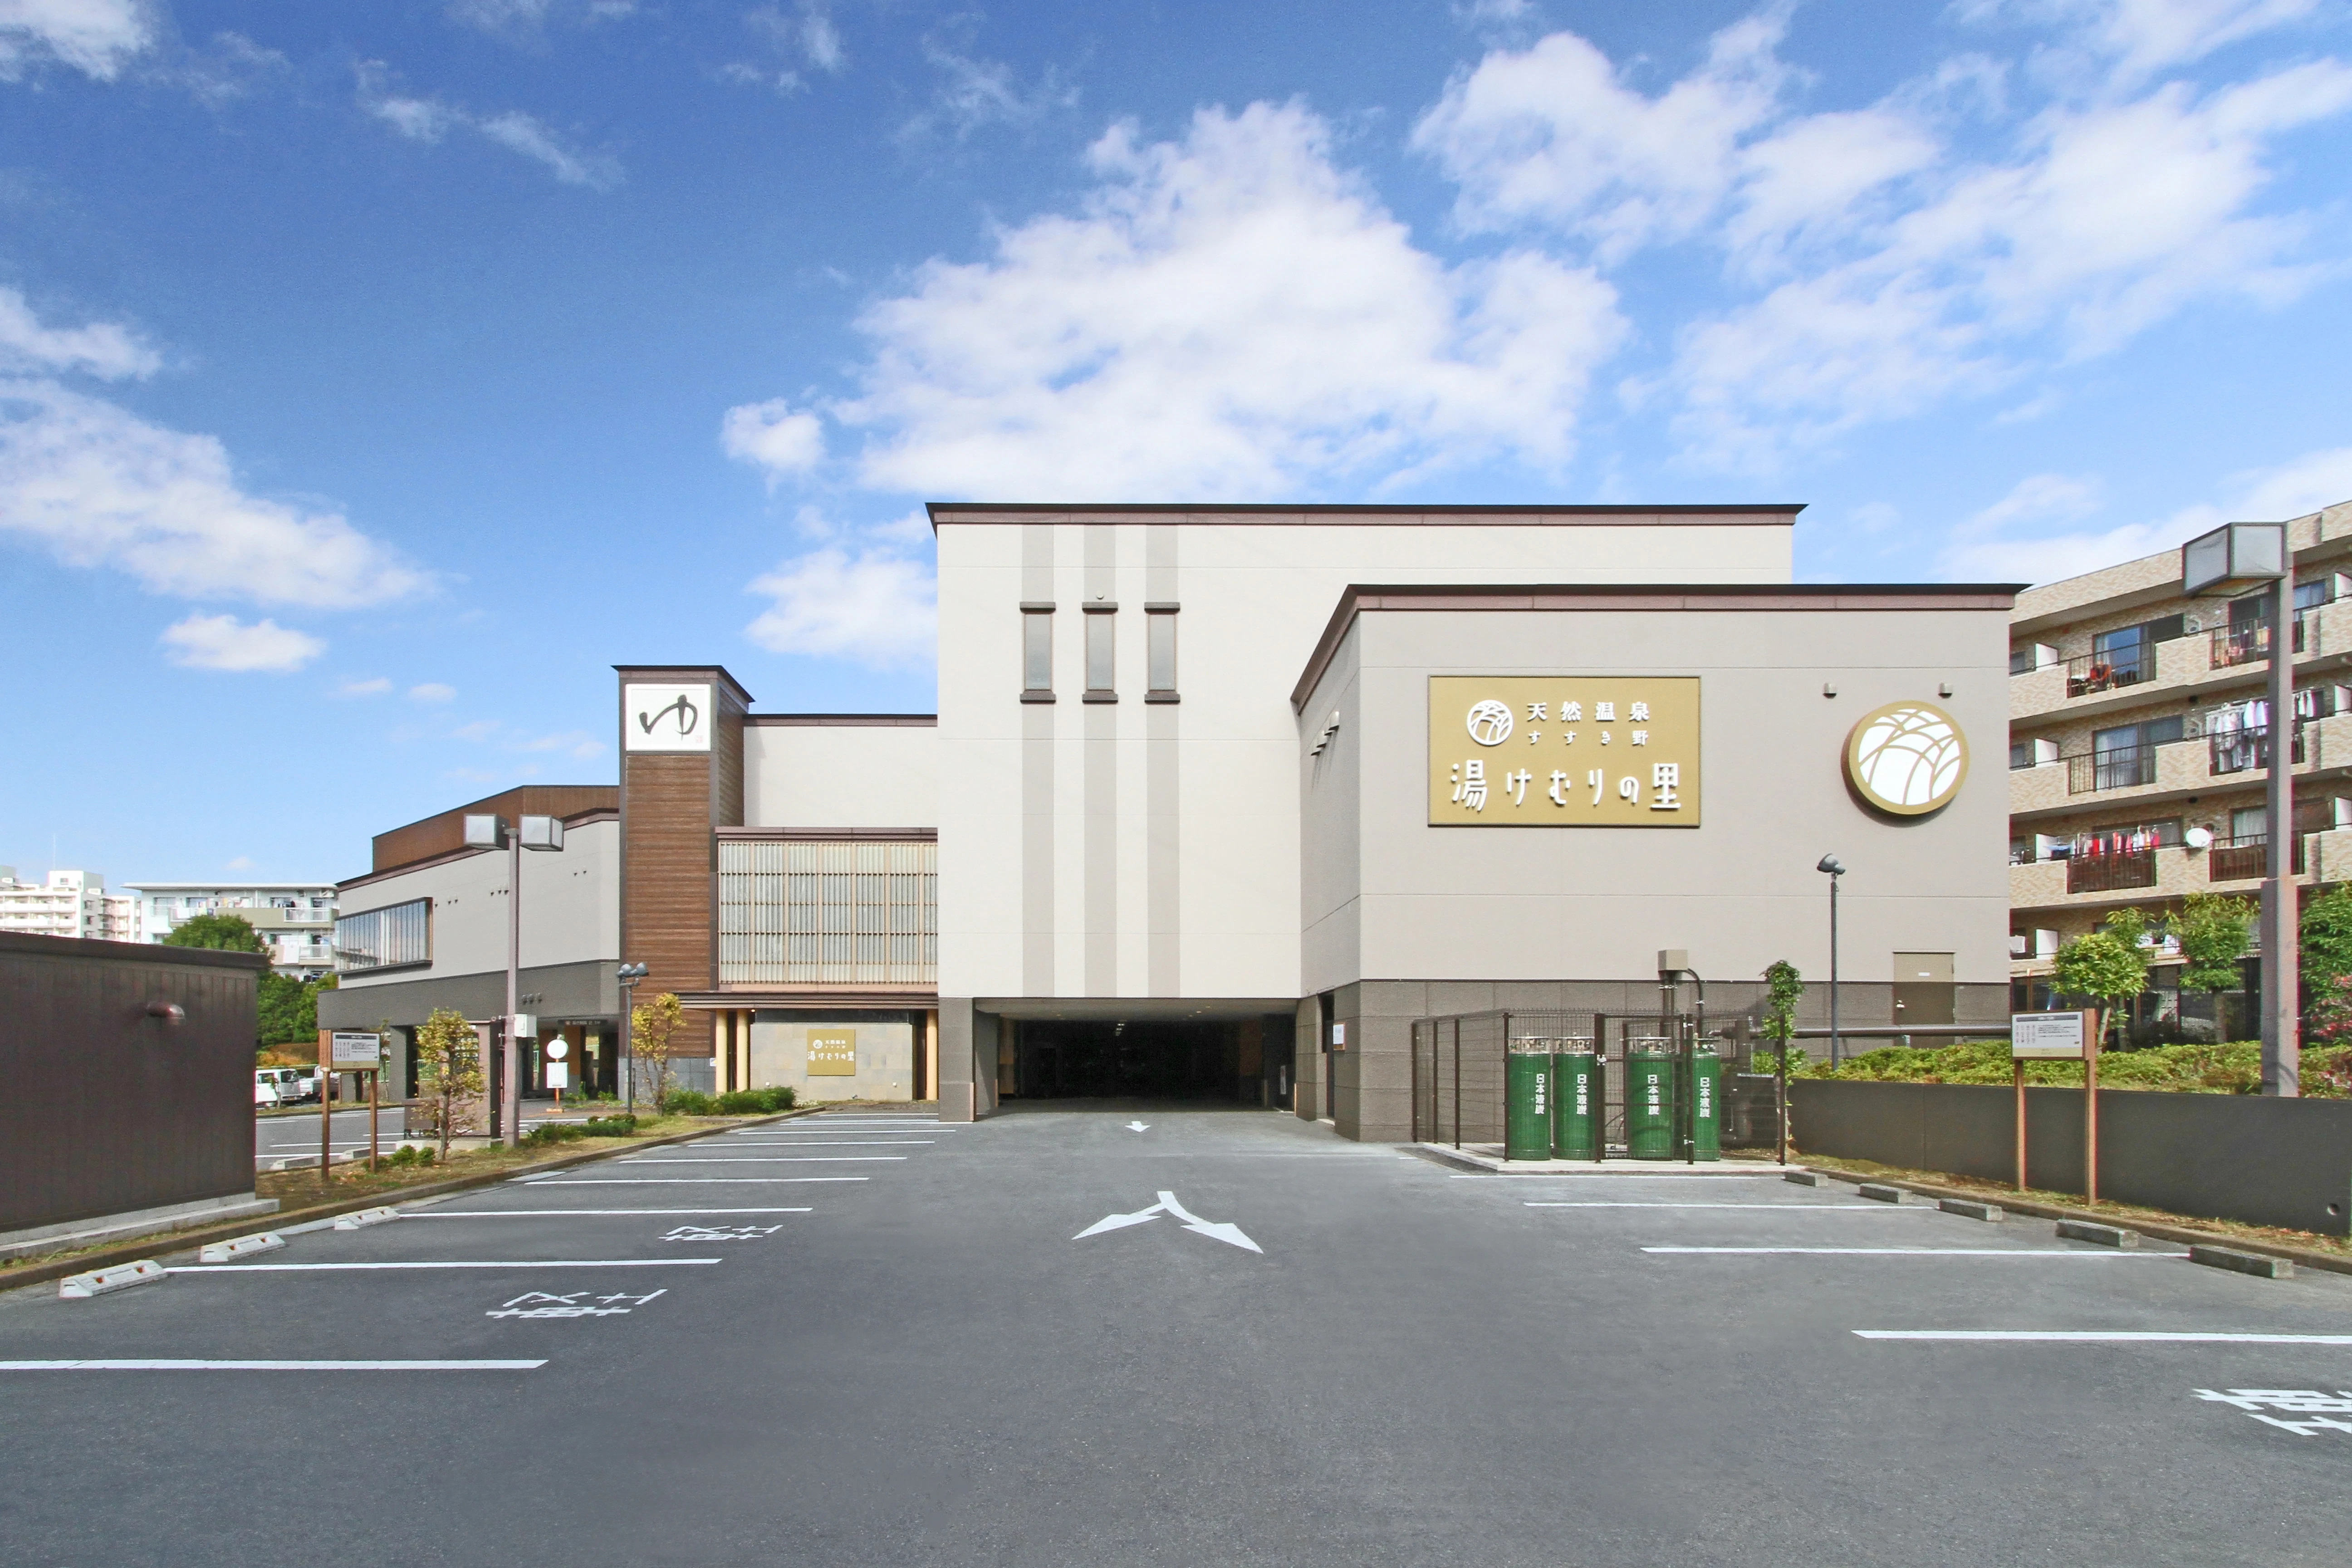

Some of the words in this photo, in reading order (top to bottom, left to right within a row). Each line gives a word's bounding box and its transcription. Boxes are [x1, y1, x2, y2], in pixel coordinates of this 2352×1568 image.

[639, 694, 698, 741] ゆ
[1527, 701, 1650, 722] 天然温泉
[1529, 730, 1648, 745] すすき野
[1450, 759, 1681, 812] 湯けむりの里
[808, 1050, 854, 1061] 湯けむりの里
